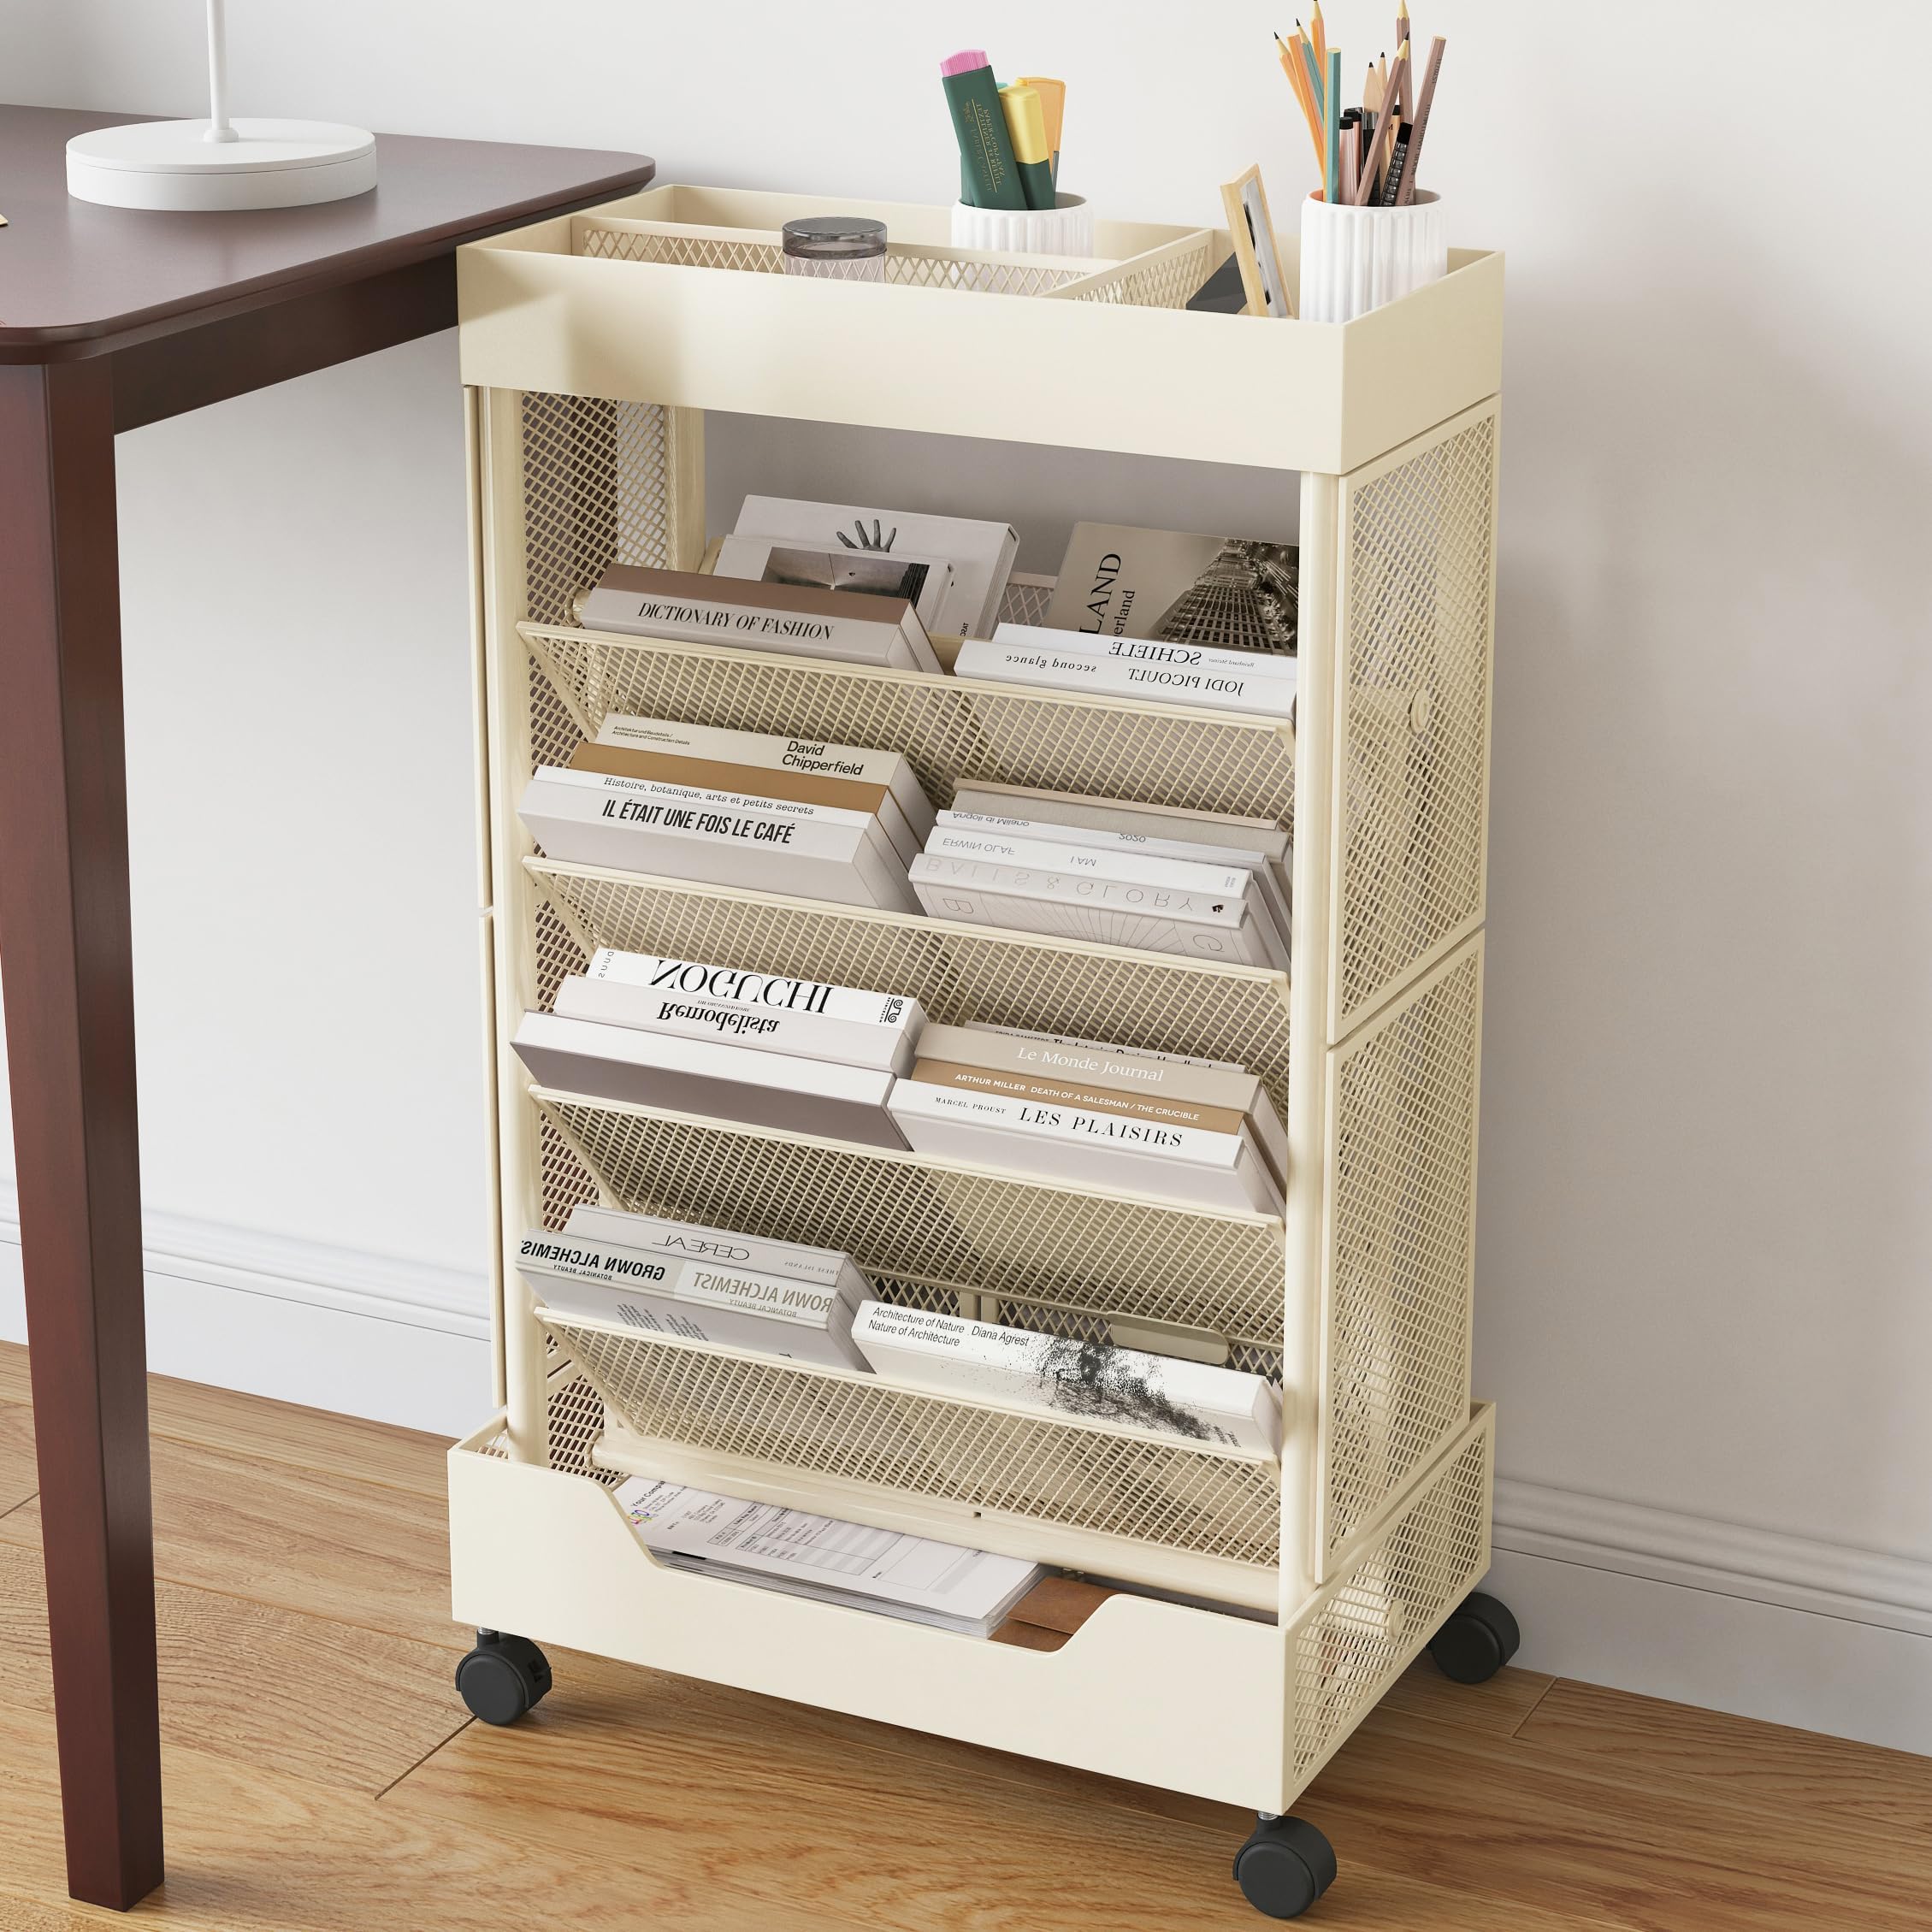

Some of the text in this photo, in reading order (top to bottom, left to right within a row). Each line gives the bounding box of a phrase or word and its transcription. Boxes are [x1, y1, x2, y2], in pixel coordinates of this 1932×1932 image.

[637, 601, 836, 641] DICTIONARY OF FASHION
[1114, 589, 1136, 637] erland
[782, 754, 864, 776] Chipperfield
[787, 740, 825, 756] David
[603, 777, 814, 816] Histoire, botanique, arts et petits secrets
[602, 799, 795, 844] IL ÉTAIT UNE FOIS LE CAFÉ
[1017, 1047, 1037, 1061] Le
[1041, 1051, 1099, 1071] Monde
[1101, 1061, 1164, 1082] Journal
[954, 1073, 992, 1086] ARTHUR
[993, 1080, 1026, 1091] MILLER
[1031, 1086, 1061, 1097] DEATH
[1082, 1095, 1129, 1109] SALESMAN
[1137, 1104, 1155, 1114] THE
[1155, 1108, 1200, 1121] CRUCIBLE
[935, 1096, 1183, 1147] MARCEL PROUST LES PLAISIRS
[868, 1319, 960, 1347] Nature of Architecture
[872, 1307, 1030, 1347] Architecture of Nature Diana Agrest
